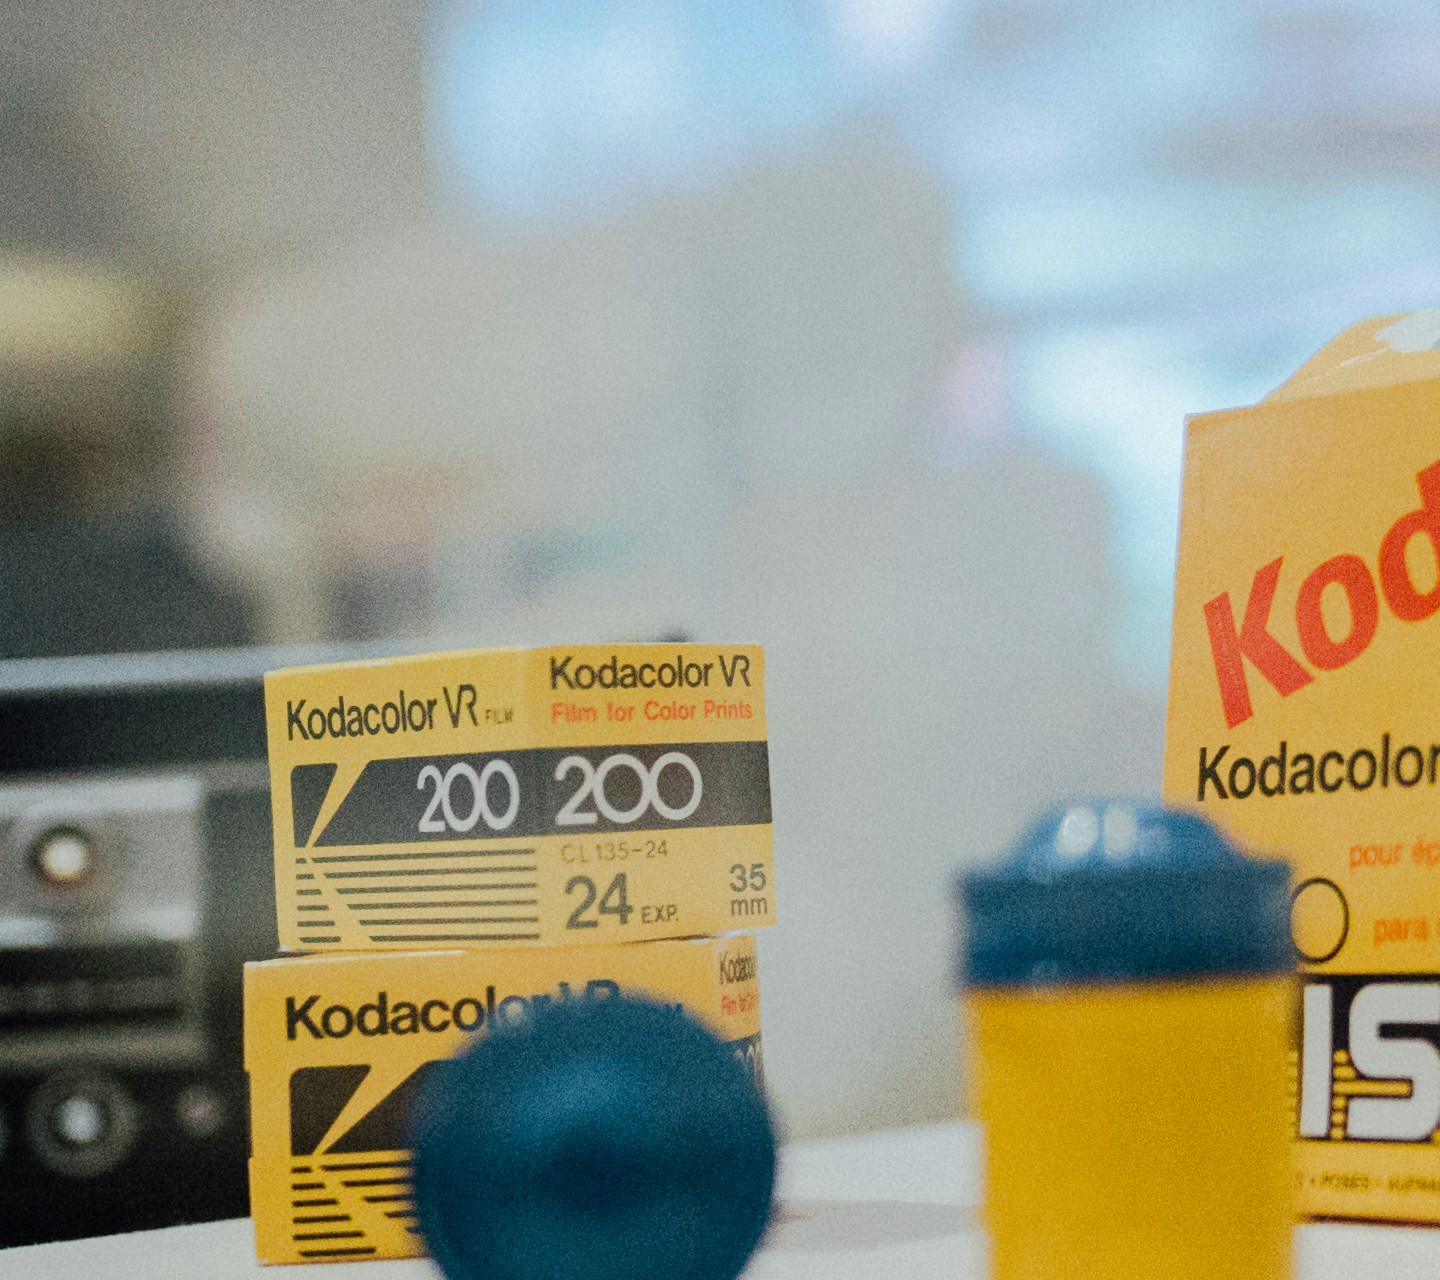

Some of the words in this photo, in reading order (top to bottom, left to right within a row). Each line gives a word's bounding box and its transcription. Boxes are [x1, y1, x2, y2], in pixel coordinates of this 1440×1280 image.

[549, 655, 714, 690] Kodacolor
[718, 654, 751, 687] VR
[287, 688, 437, 741] Kodacolor
[443, 683, 479, 727] VR
[550, 702, 597, 723] Film
[606, 701, 635, 722] for
[643, 700, 696, 721] Color
[703, 699, 753, 720] Prints
[417, 758, 520, 832] 200
[554, 751, 703, 825] 200
[729, 863, 767, 892] 35
[1348, 843, 1404, 871] pour
[565, 872, 634, 929] 24
[641, 904, 680, 924] EXP.
[730, 897, 769, 916] mm
[285, 984, 552, 1041] Kodacolo
